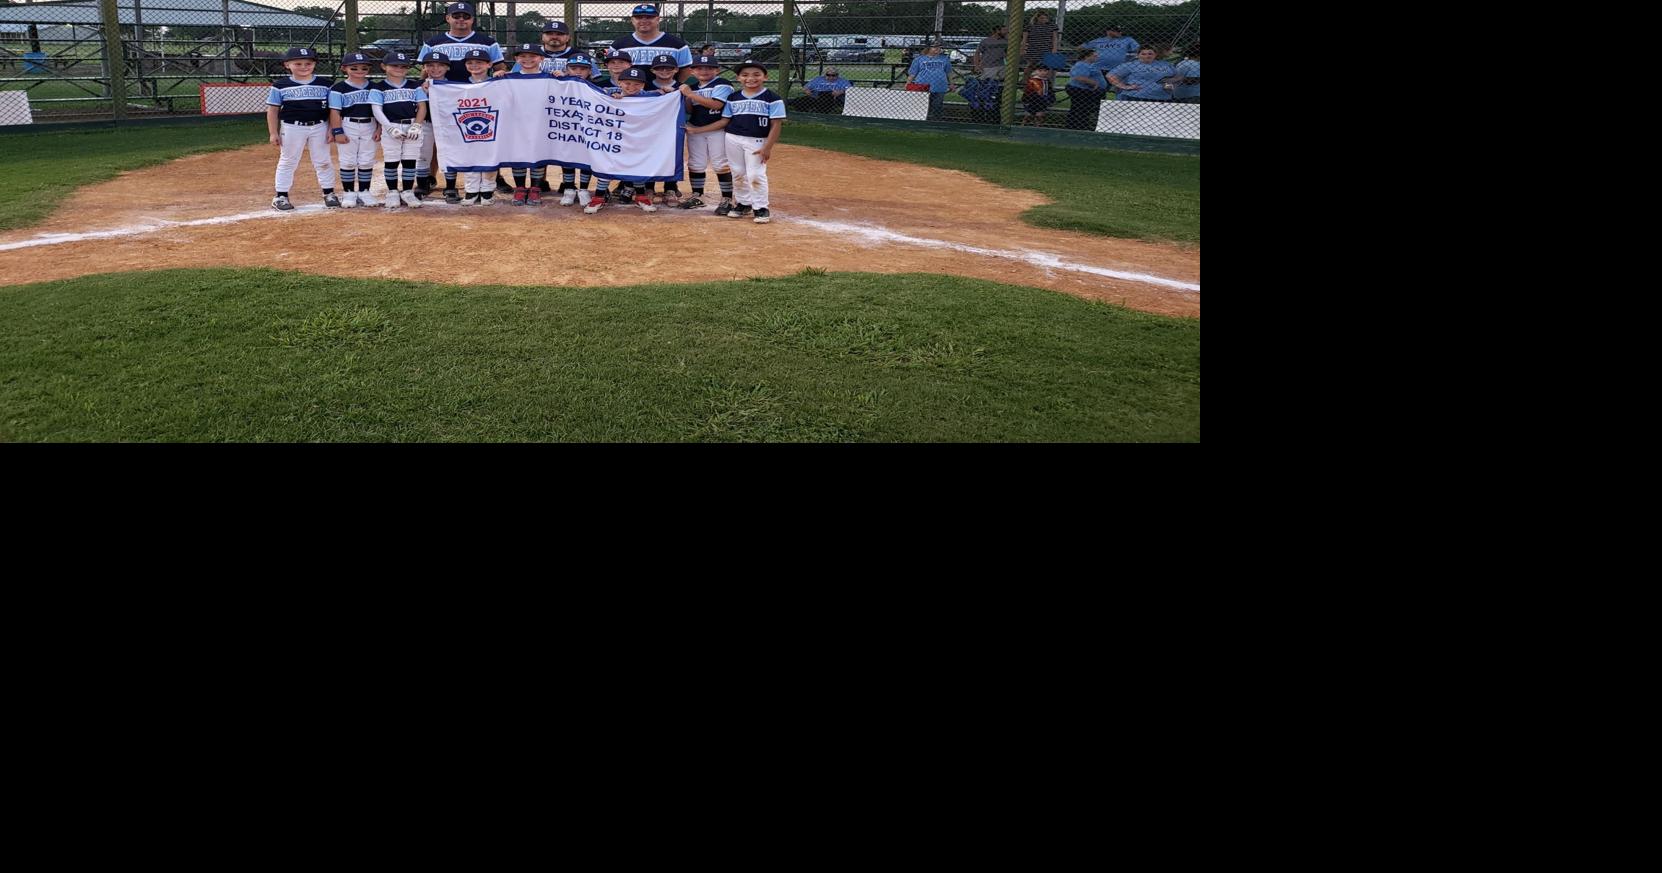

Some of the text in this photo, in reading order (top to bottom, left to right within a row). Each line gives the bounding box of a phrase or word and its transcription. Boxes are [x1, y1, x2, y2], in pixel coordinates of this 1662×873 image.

[630, 69, 638, 77] S
[457, 98, 488, 107] 2021
[548, 95, 626, 117] 9 YEAR OLD
[545, 107, 624, 129] TEXAS EAST
[758, 117, 768, 127] 10
[549, 119, 623, 141] DISTICT 18
[547, 131, 621, 153] CHAMIONS
